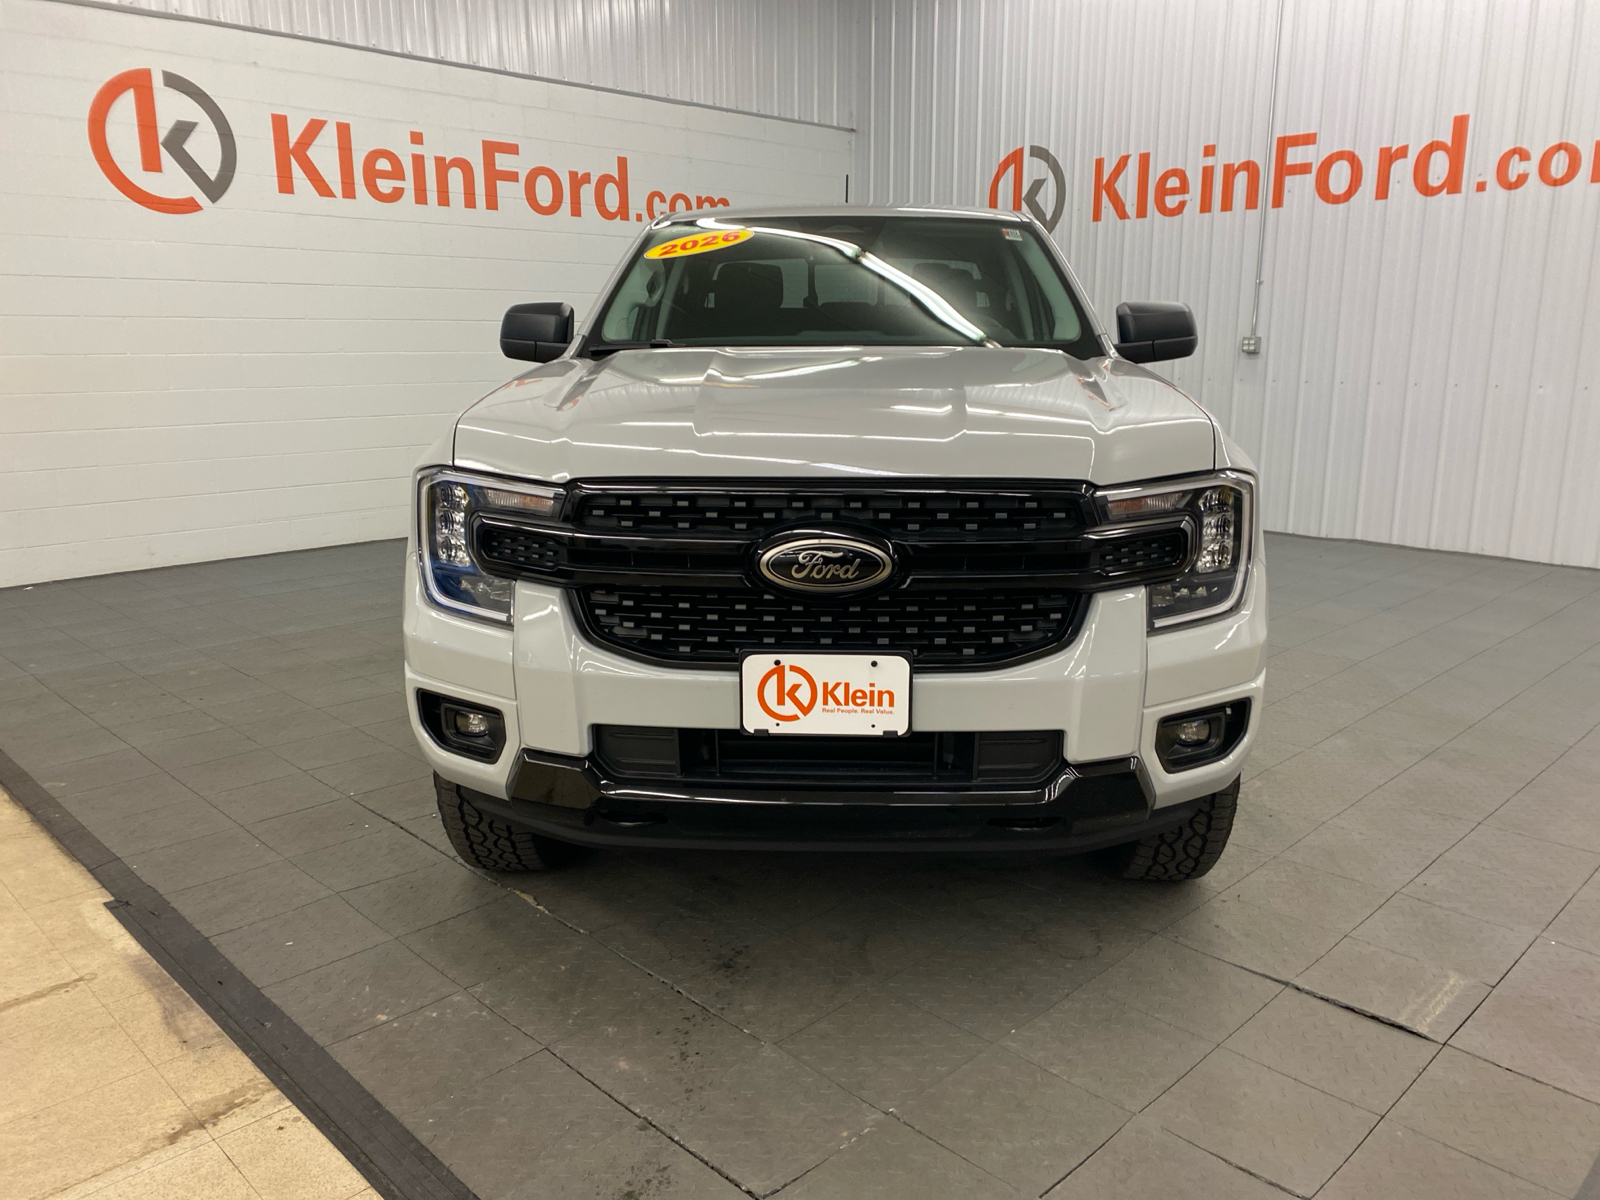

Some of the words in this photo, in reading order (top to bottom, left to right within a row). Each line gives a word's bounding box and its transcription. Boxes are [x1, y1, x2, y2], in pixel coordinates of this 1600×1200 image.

[1091, 113, 1600, 222] KleinFord.co
[658, 231, 740, 256] 2026
[791, 550, 861, 579] Ford
[822, 681, 895, 708] Klein
